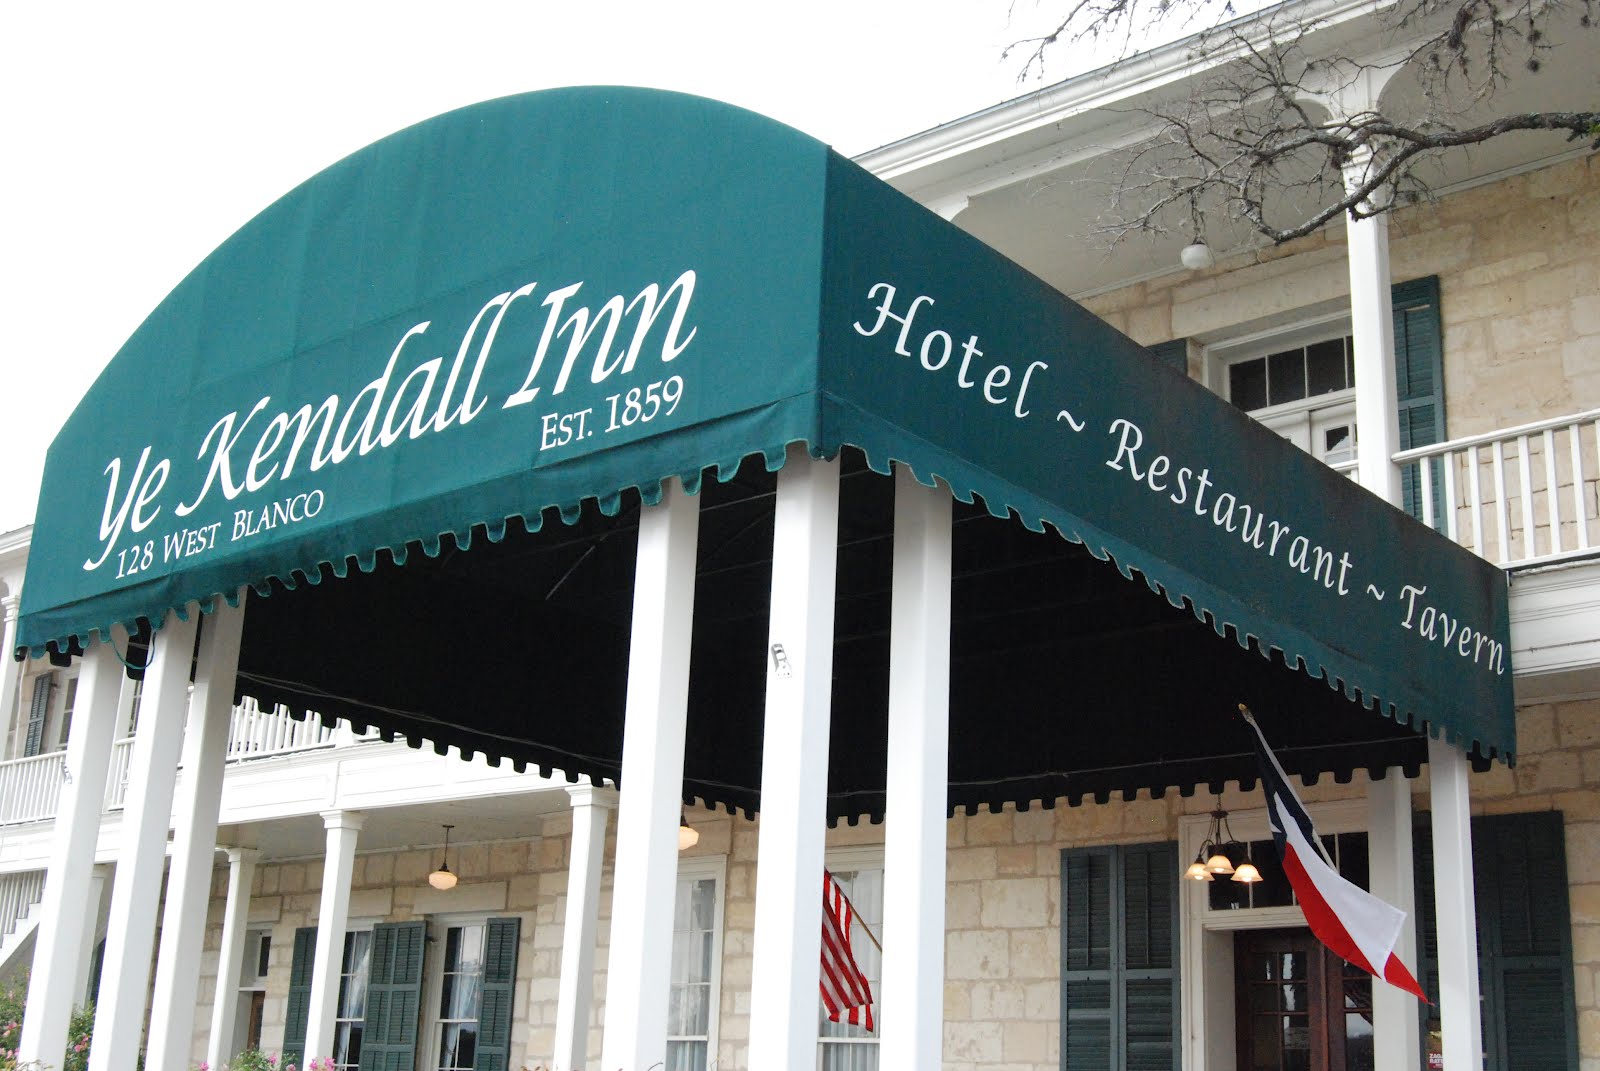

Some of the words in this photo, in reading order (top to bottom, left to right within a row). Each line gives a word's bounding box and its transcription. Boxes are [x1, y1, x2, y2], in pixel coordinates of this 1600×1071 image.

[82, 445, 171, 572] Ye
[174, 281, 538, 517] Kendall
[501, 269, 698, 410] Inn
[539, 405, 593, 452] EST.
[604, 374, 684, 433] 1859
[853, 282, 1049, 418] Hotel
[1105, 418, 1353, 596] Restaurant
[1399, 584, 1505, 675] Tavern
[115, 539, 155, 580] 128
[163, 521, 222, 564] WEST
[230, 489, 325, 542] BLANCO
